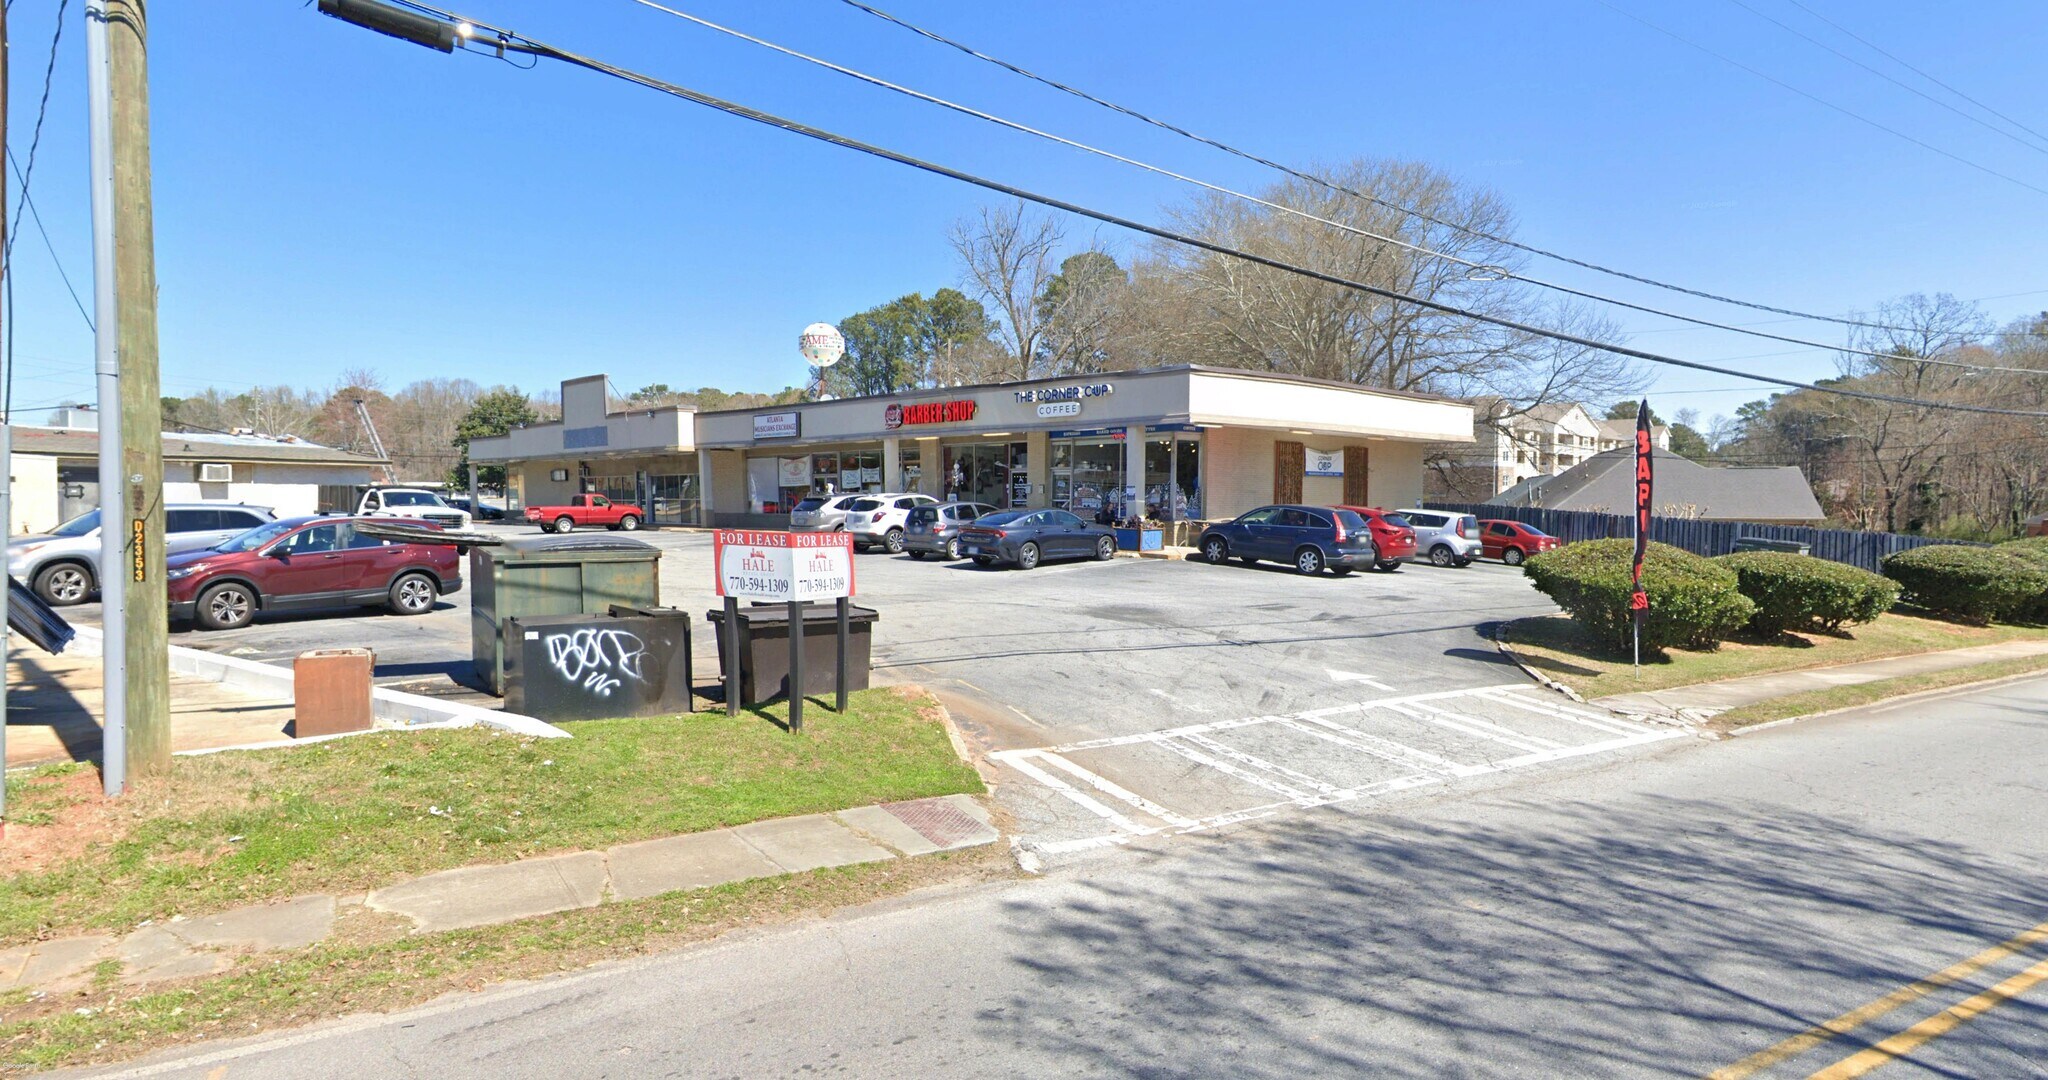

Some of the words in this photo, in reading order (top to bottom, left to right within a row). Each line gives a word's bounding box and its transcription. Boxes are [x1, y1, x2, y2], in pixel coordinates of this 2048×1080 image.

[1014, 391, 1034, 403] THE
[1037, 387, 1080, 401] CORNER
[1084, 384, 1111, 397] CUP
[903, 403, 943, 425] BARBER
[945, 400, 975, 422] SHOP
[1039, 404, 1077, 415] COFFEE
[755, 424, 776, 433] MUSICIANS
[776, 422, 796, 431] EXCHANGE
[720, 532, 745, 545] FOR
[749, 533, 787, 547] LEASE
[797, 535, 817, 547] FOR
[820, 534, 850, 546] LEASE
[134, 520, 144, 581] D2353
[742, 558, 775, 572] HALE
[809, 560, 834, 573] HALE
[729, 576, 789, 594] 770-594-1309
[799, 576, 845, 593] 770-594-1309
